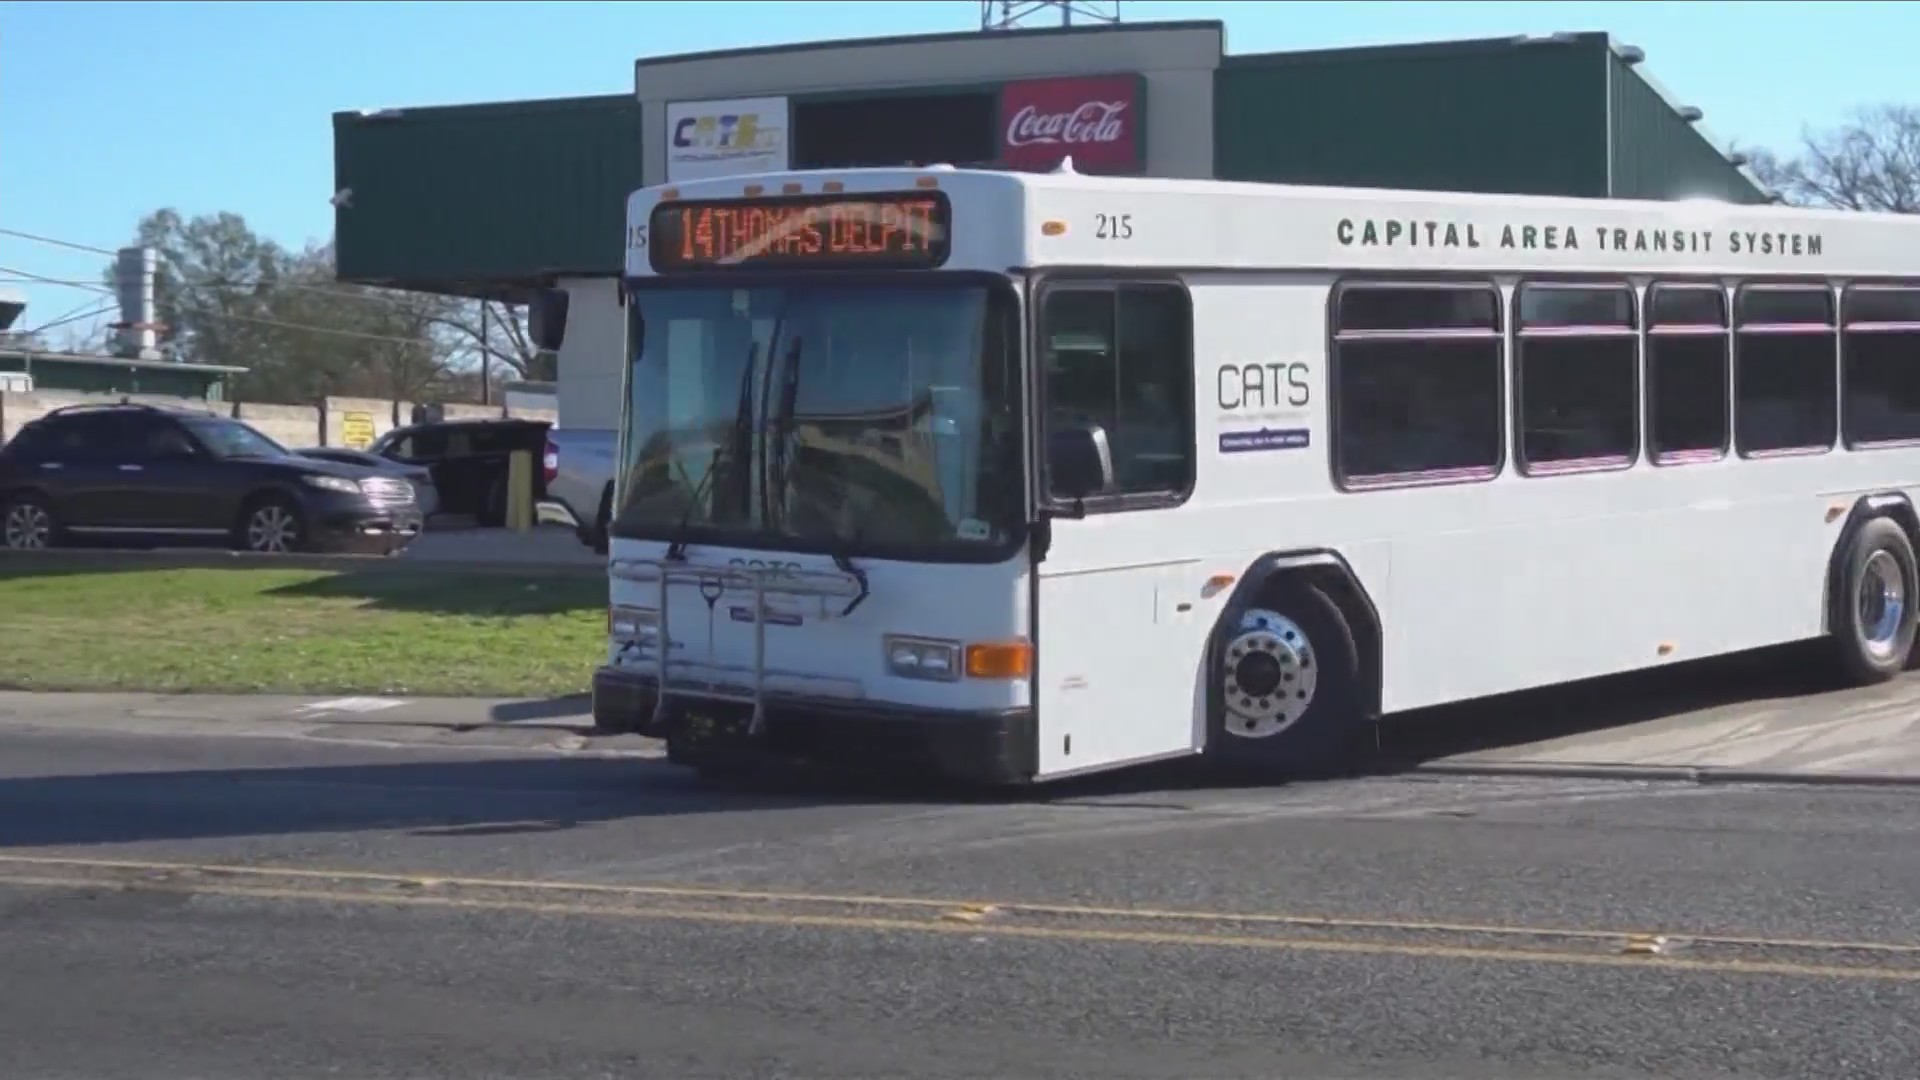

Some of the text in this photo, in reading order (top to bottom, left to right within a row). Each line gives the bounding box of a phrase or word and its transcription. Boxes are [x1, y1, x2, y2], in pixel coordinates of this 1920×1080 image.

[830, 202, 936, 252] DELPIT
[1095, 213, 1133, 239] 215
[1337, 218, 1822, 255] CAPITAL AREA TRANSIT SYSTEM
[1218, 362, 1309, 409] CATS
